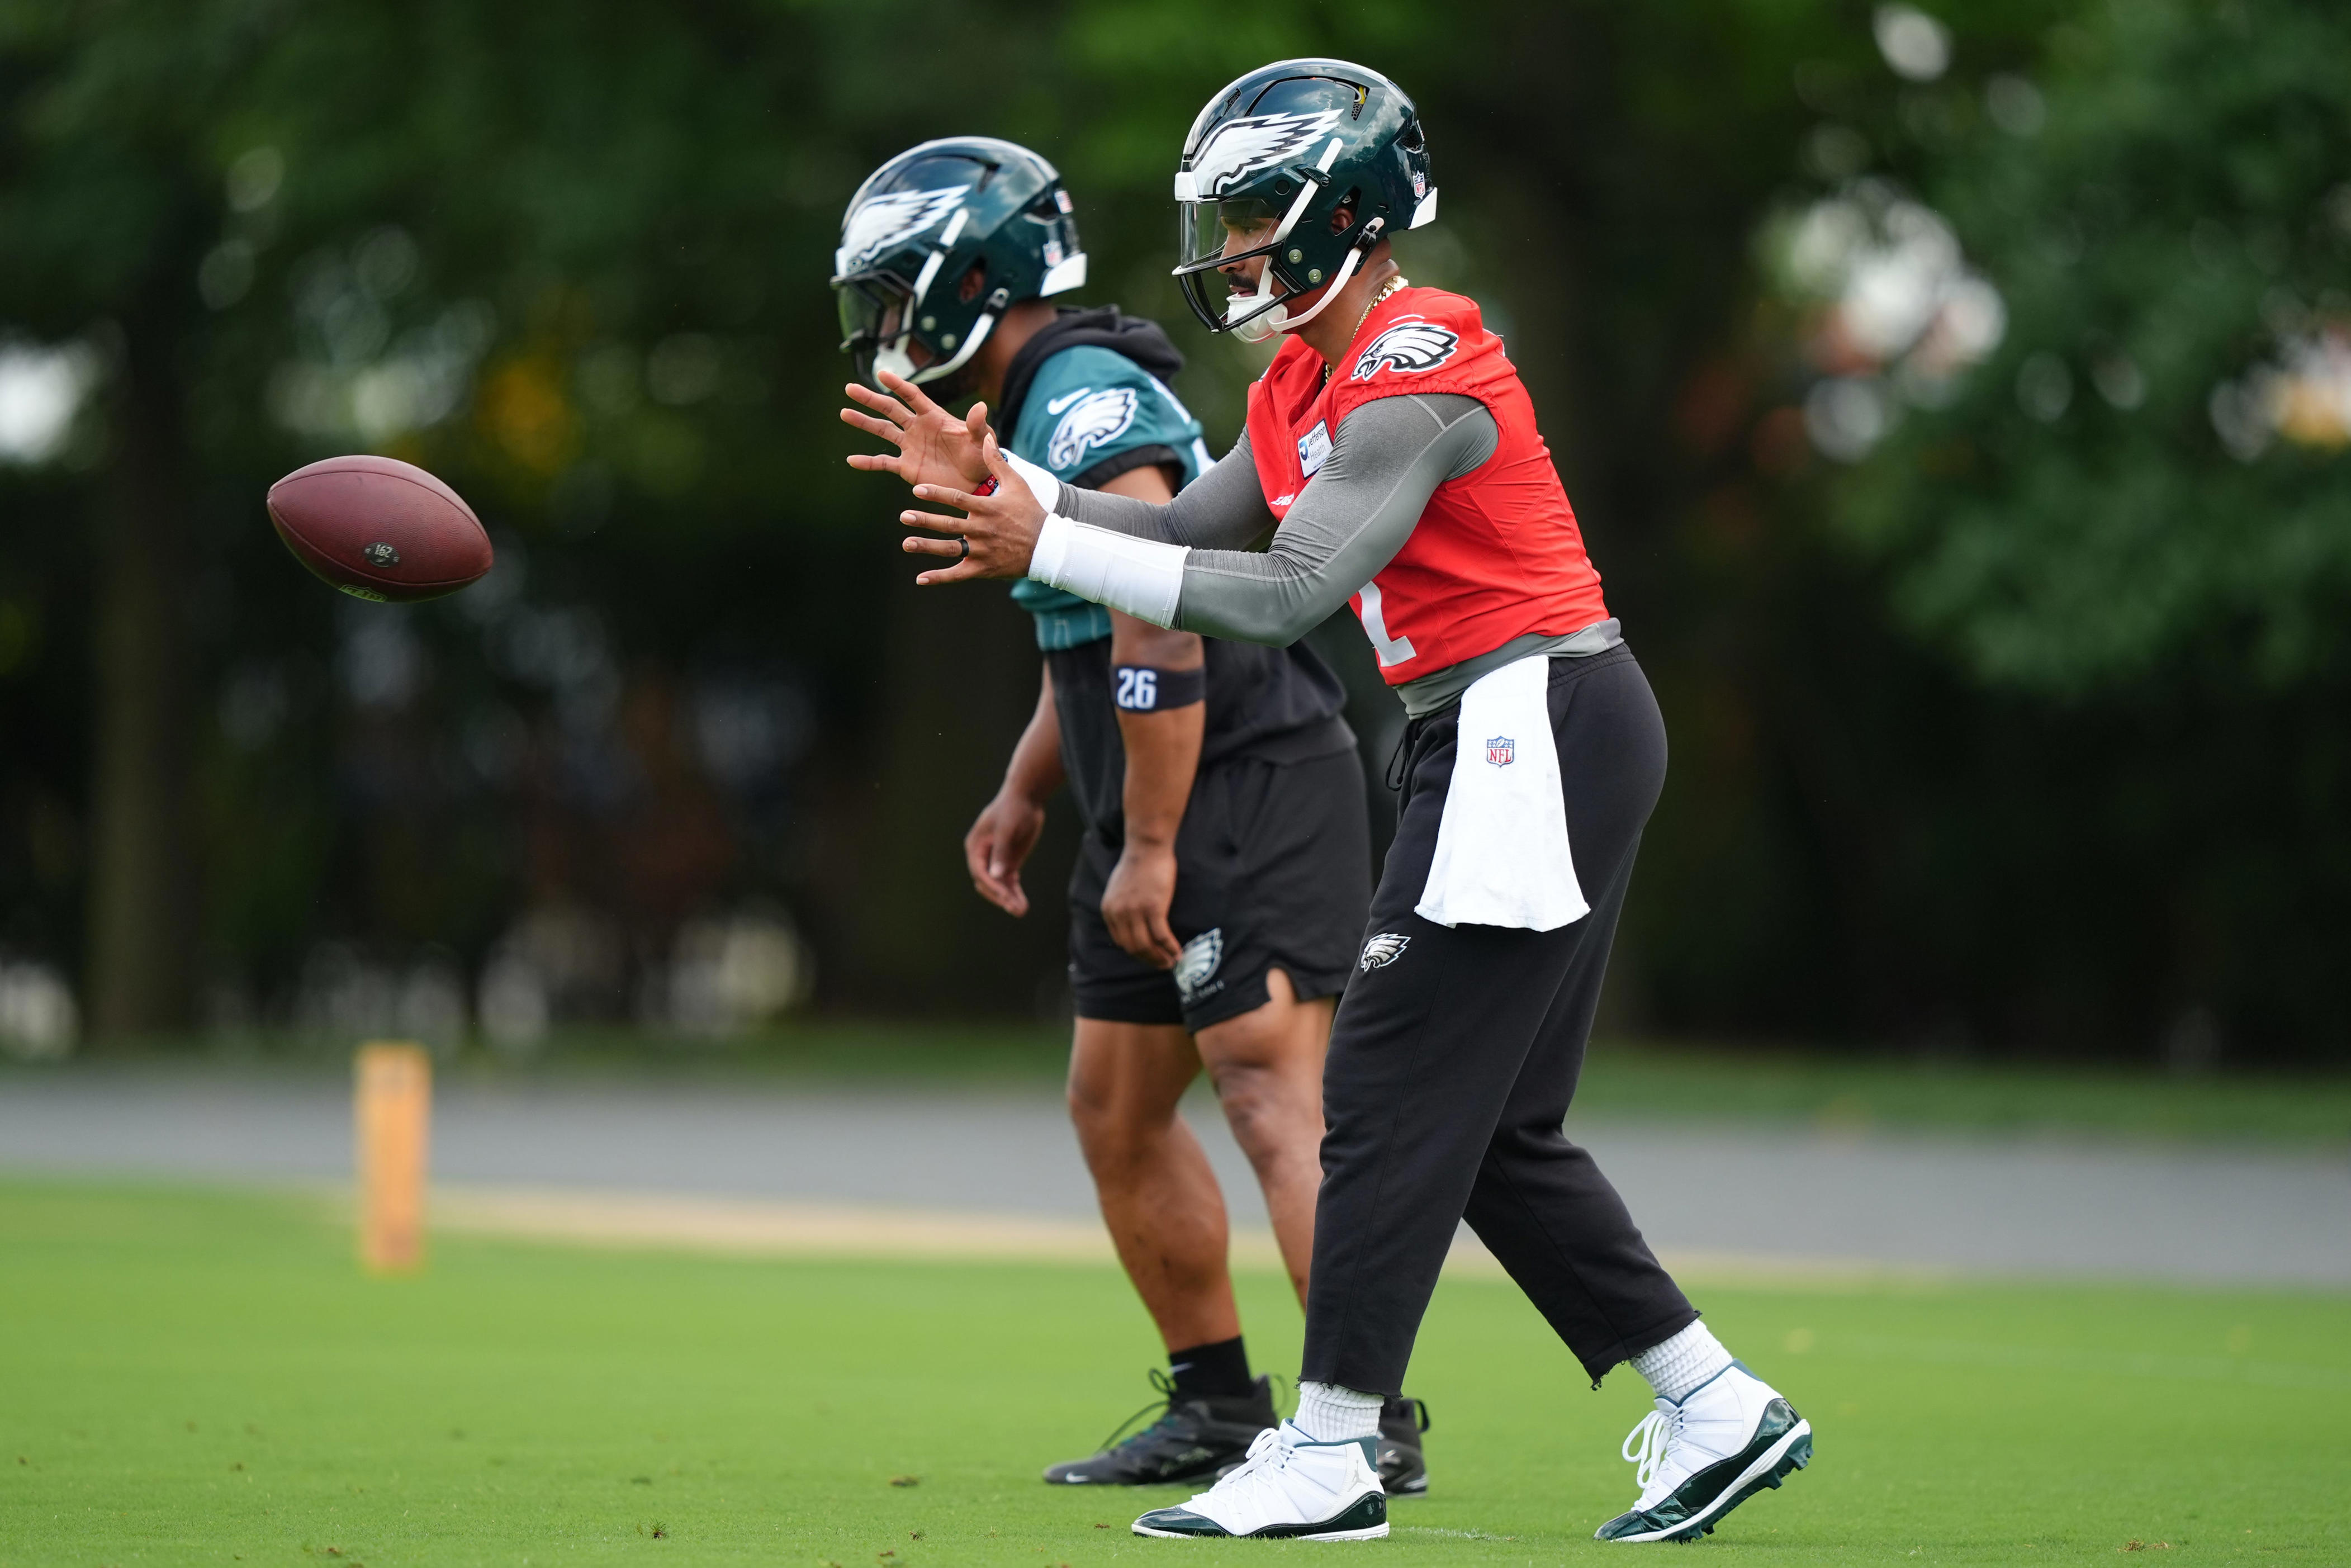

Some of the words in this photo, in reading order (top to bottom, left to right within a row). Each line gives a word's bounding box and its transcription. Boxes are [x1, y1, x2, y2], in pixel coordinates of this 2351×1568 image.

[1415, 183, 1424, 194] NFL
[1309, 426, 1326, 447] Jefferson
[1310, 443, 1326, 461] Health
[1117, 667, 1157, 710] 26
[1489, 749, 1511, 763] NFL
